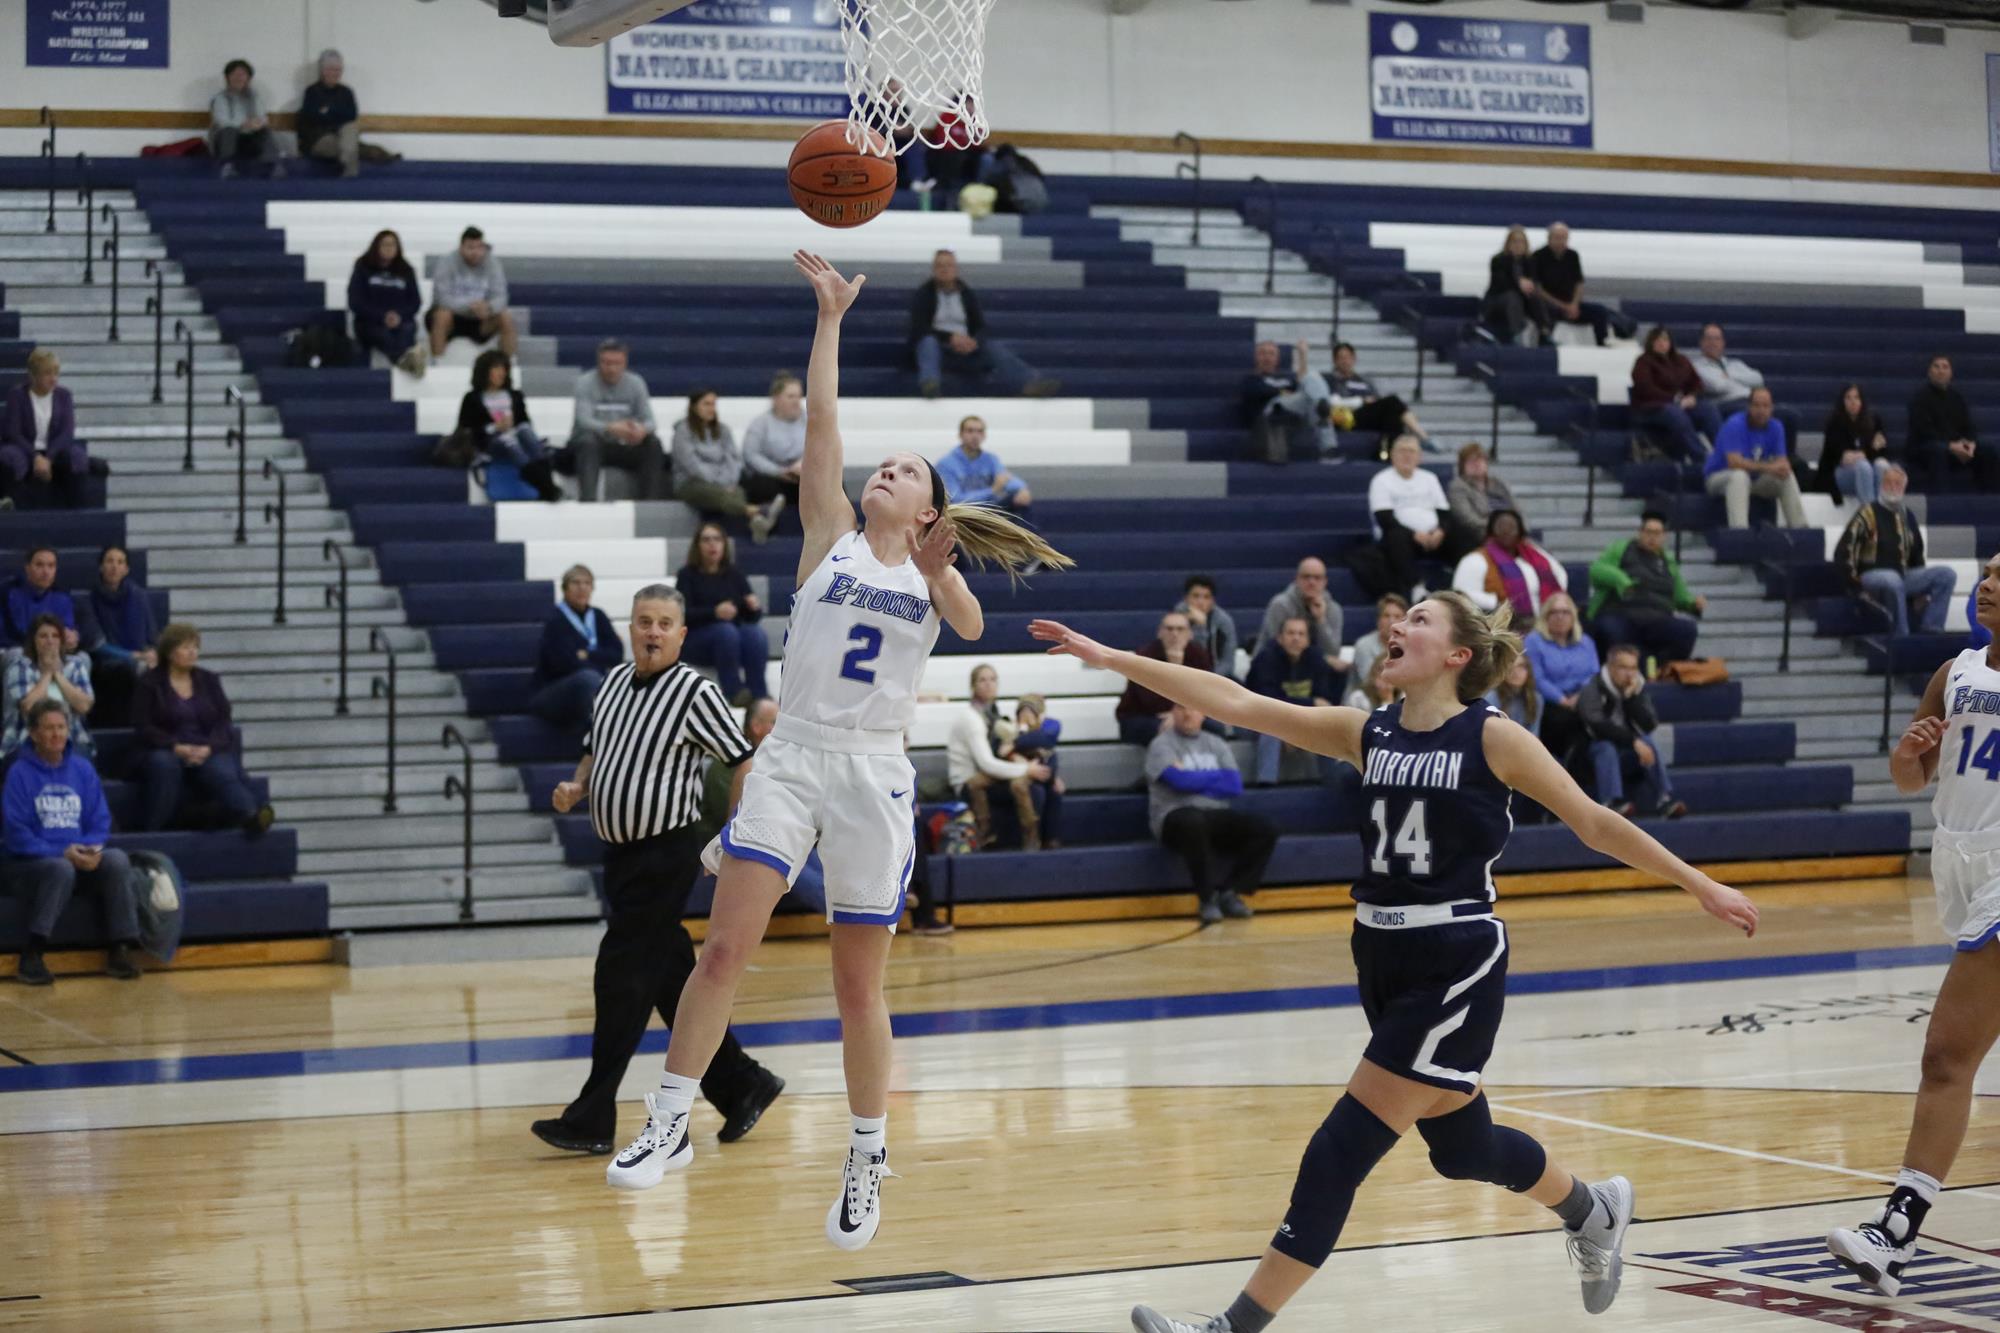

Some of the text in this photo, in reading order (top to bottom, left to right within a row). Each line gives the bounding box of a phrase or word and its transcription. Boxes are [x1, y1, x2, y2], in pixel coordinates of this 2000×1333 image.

[616, 54, 729, 79] NATIONAL
[1379, 85, 1474, 111] NATIONAL
[818, 571, 931, 624] E-TOWN
[839, 623, 884, 686] 2
[1953, 685, 2000, 715] E-TO
[1370, 799, 1432, 875] 14
